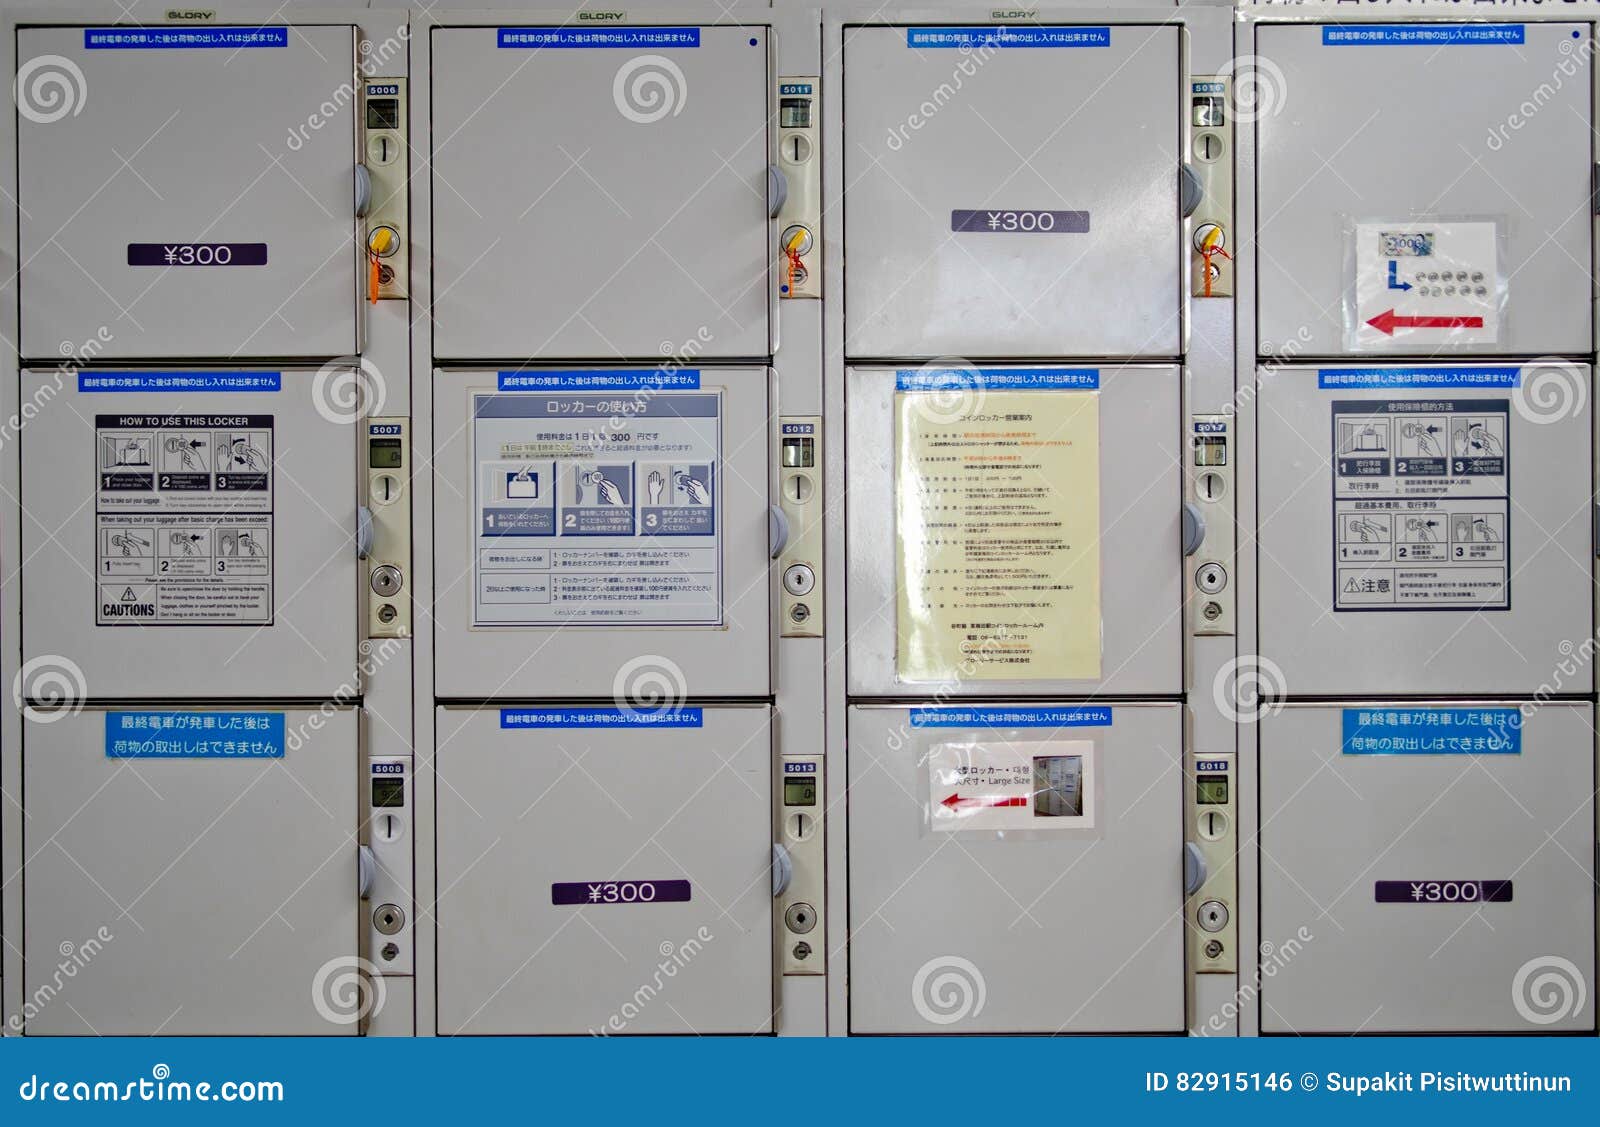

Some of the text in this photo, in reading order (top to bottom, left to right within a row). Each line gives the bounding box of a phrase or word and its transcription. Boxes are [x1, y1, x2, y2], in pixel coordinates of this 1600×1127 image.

[168, 11, 212, 20] GLORY
[784, 86, 809, 94] 5011
[988, 212, 1055, 231] ¥300
[164, 246, 232, 265] ¥300
[547, 400, 647, 413] ロッカーの使い方
[120, 417, 249, 426] HOW TO USE THIS LOCKER
[374, 426, 398, 434] 5007
[786, 425, 811, 433] 5012
[611, 433, 631, 442] 300
[1340, 463, 1347, 473] 1
[1398, 462, 1407, 473] 2
[1455, 461, 1464, 472] 3
[104, 476, 111, 488] 1
[161, 476, 170, 488] 2
[218, 476, 226, 488] 3
[116, 516, 132, 524] taking
[156, 516, 176, 524] luggage
[486, 514, 494, 528] 1
[565, 514, 577, 528] 2
[646, 514, 657, 527] 3
[1342, 548, 1347, 557] 1
[1399, 547, 1407, 557] 2
[1455, 547, 1464, 557] 3
[104, 561, 111, 571] 1
[161, 561, 169, 571] 2
[217, 561, 225, 572] 3
[1362, 579, 1391, 593] 注意
[121, 715, 270, 730] 最終電車が発車した後は
[1358, 711, 1506, 727] 最終電車が発車した後は
[114, 740, 278, 755] 荷物の取出しはできません
[376, 765, 401, 773] 5008
[789, 764, 814, 772] 5013
[1200, 762, 1225, 771] 5018
[988, 778, 1011, 786] Large
[1014, 777, 1031, 785] Size
[588, 883, 656, 903] ¥300
[1411, 882, 1478, 901] ¥300
